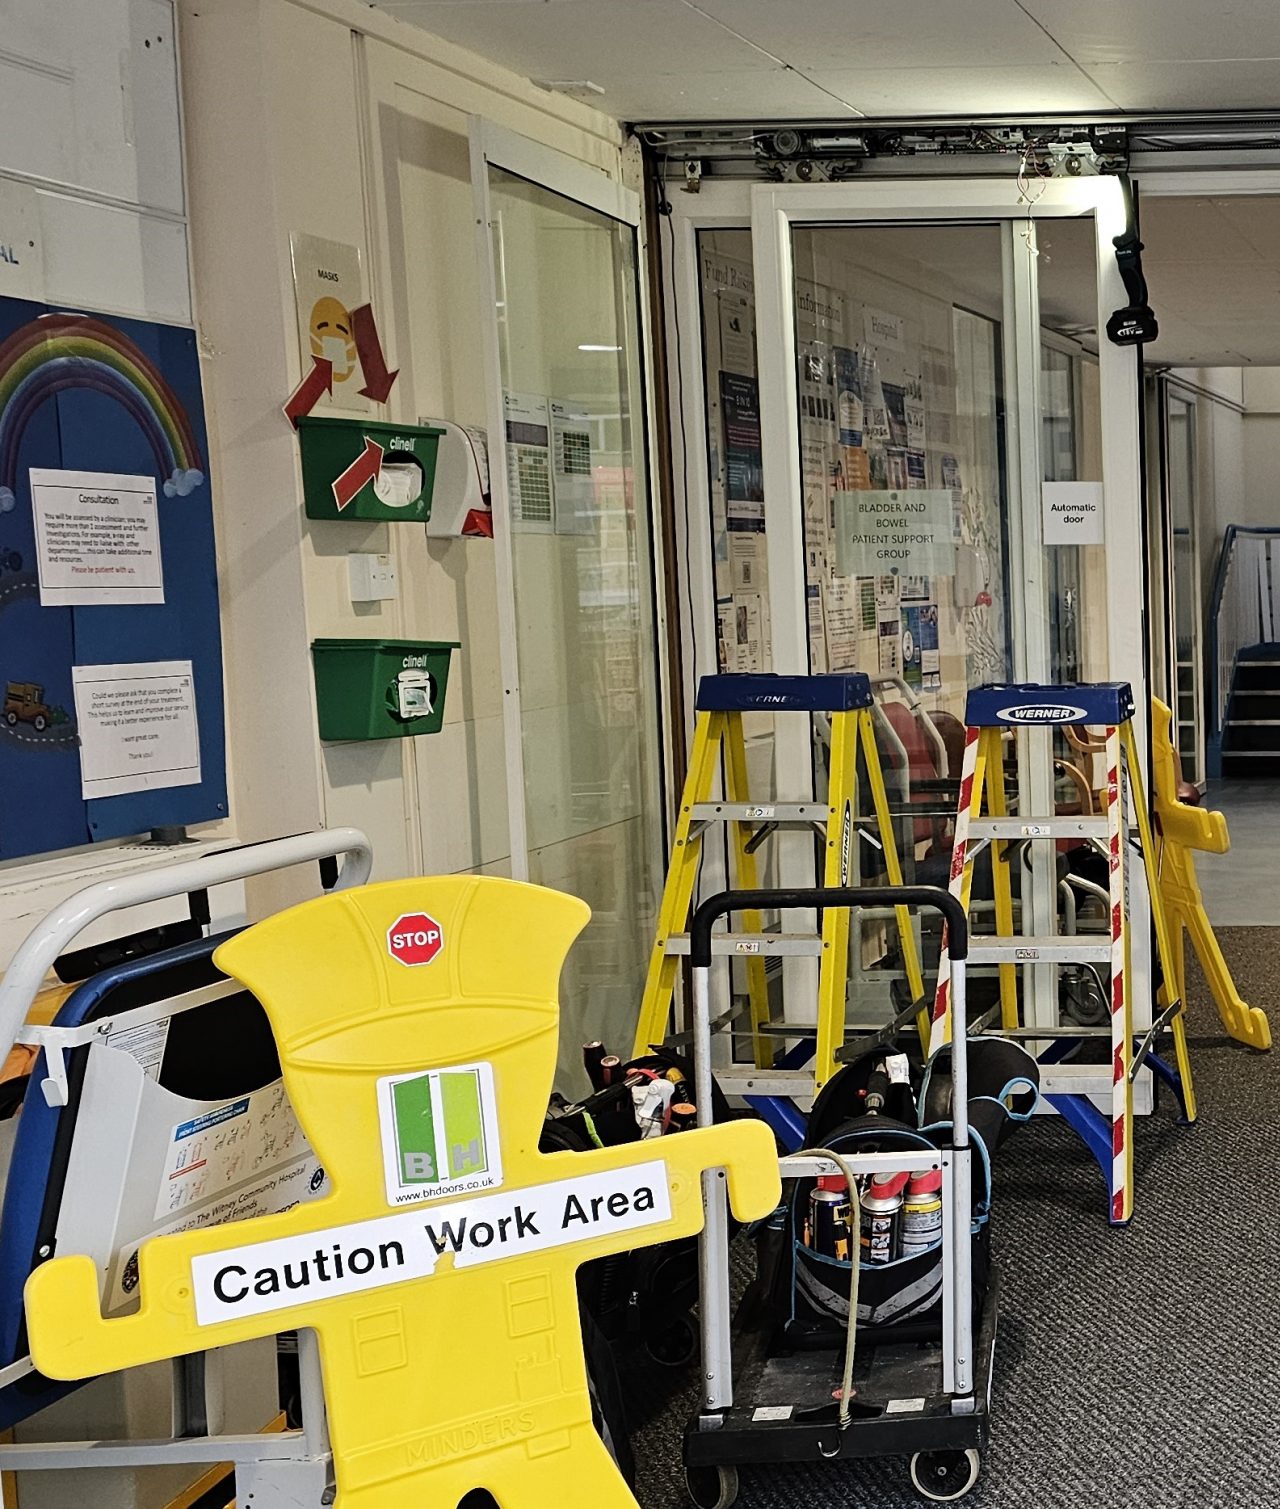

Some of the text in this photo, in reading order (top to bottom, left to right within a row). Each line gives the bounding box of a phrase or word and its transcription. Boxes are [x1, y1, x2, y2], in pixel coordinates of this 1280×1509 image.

[317, 269, 339, 282] MASKS
[389, 437, 415, 451] clinell
[79, 494, 119, 505] Consultation
[858, 503, 926, 513] BLADDER AND
[1050, 502, 1096, 513] Automatic
[876, 519, 909, 528] BOWEL
[1062, 514, 1085, 525] door
[852, 535, 934, 544] PATIENT SUPPORT
[876, 550, 911, 559] GROUP
[402, 654, 428, 668] clinell
[1014, 709, 1071, 718] WERNER
[392, 928, 439, 950] STOP
[238, 1181, 277, 1203] Community
[278, 1163, 307, 1185] Hospital
[395, 1177, 494, 1204] www.bhdoors.co.uk
[211, 1183, 656, 1305] Caution Work Area
[406, 1412, 536, 1466] MINDERS
